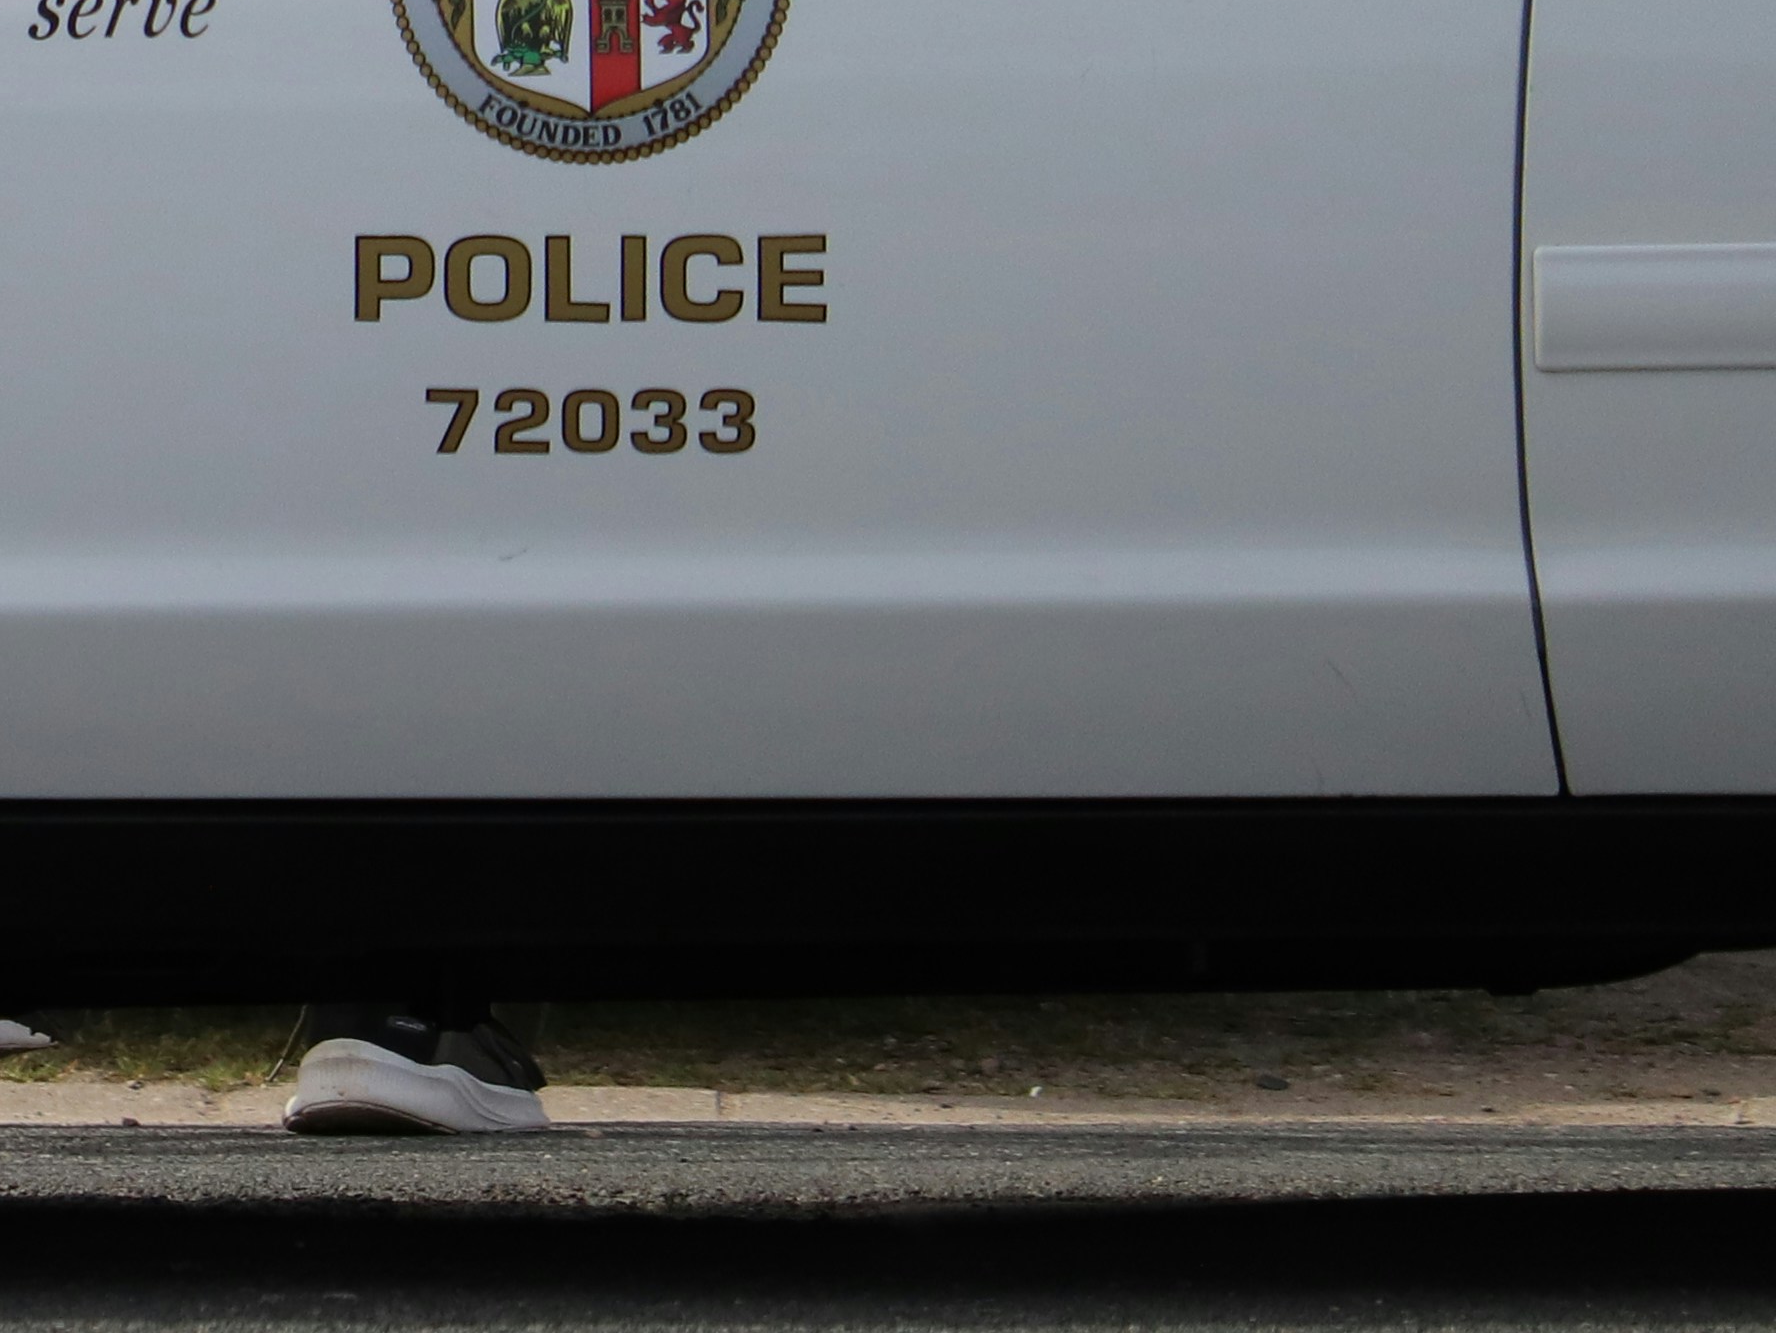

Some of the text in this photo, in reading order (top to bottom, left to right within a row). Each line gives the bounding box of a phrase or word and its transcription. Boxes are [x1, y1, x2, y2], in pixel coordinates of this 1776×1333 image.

[478, 92, 705, 148] FOUNDED 1781
[353, 234, 827, 323] POLICE
[425, 387, 756, 454] 72033
